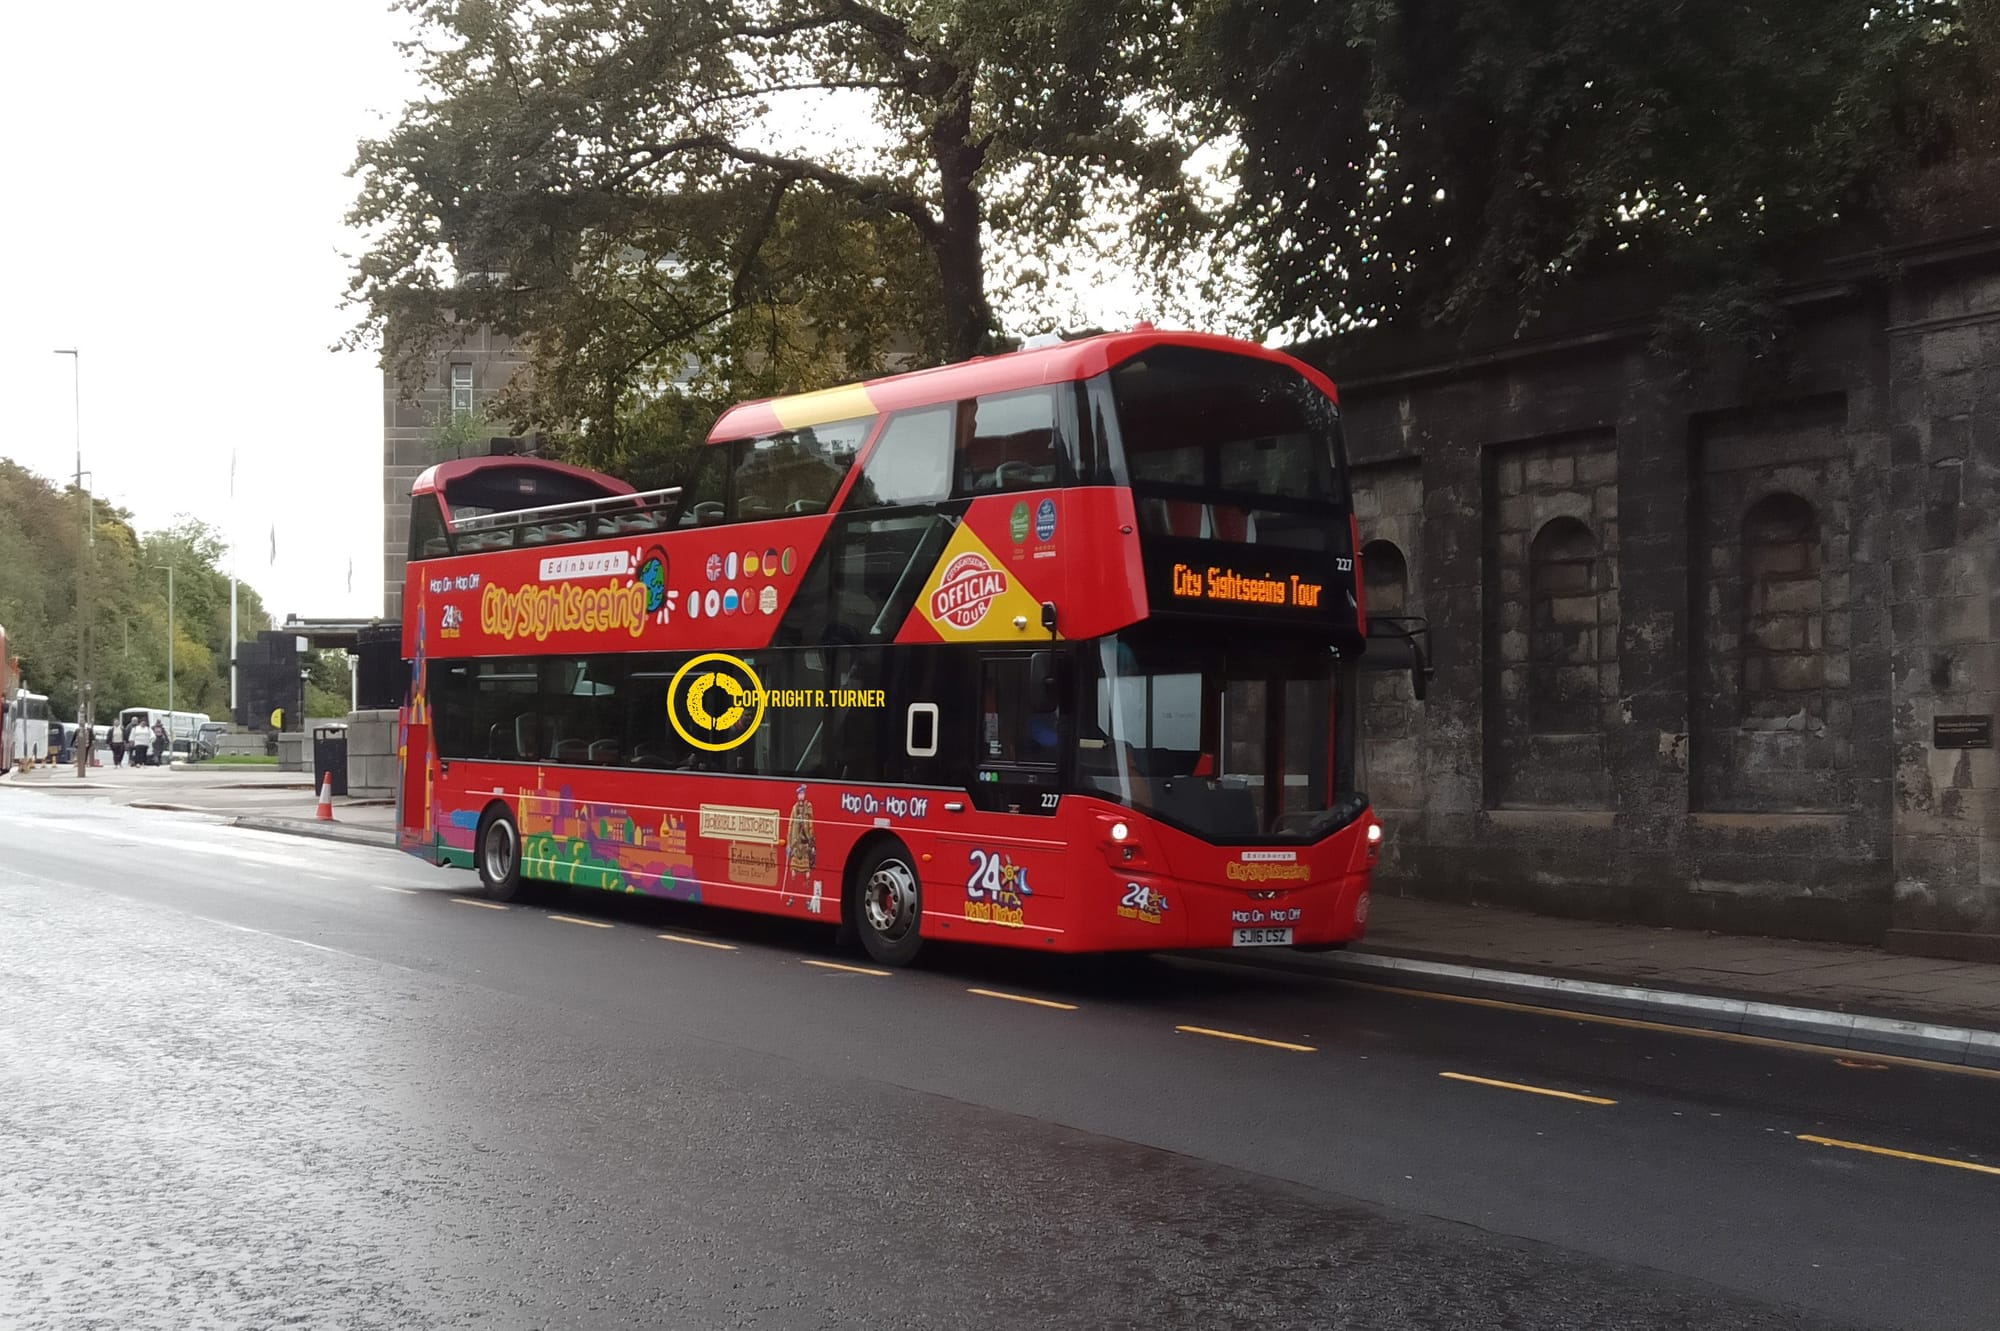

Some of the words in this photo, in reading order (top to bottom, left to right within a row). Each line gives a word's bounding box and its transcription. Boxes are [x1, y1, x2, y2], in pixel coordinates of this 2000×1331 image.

[548, 556, 619, 574] Edinburgh
[1336, 558, 1352, 571] 227
[937, 573, 1004, 613] OFFICIAL
[1173, 563, 1202, 597] City
[1207, 566, 1286, 603] Sightseeing
[1290, 575, 1322, 607] Tour
[956, 601, 987, 624] TOUR
[841, 793, 861, 813] Hop
[864, 793, 878, 813] On
[886, 796, 907, 817] Hop
[909, 797, 928, 816] Off
[1041, 793, 1059, 808] 227
[731, 847, 776, 872] Edinburgh
[967, 850, 1001, 900] 24
[1121, 883, 1150, 909] 24
[1232, 911, 1250, 922] Hop
[1252, 909, 1264, 921] On
[1270, 910, 1286, 921] Hop
[1266, 929, 1286, 942] CSZ
